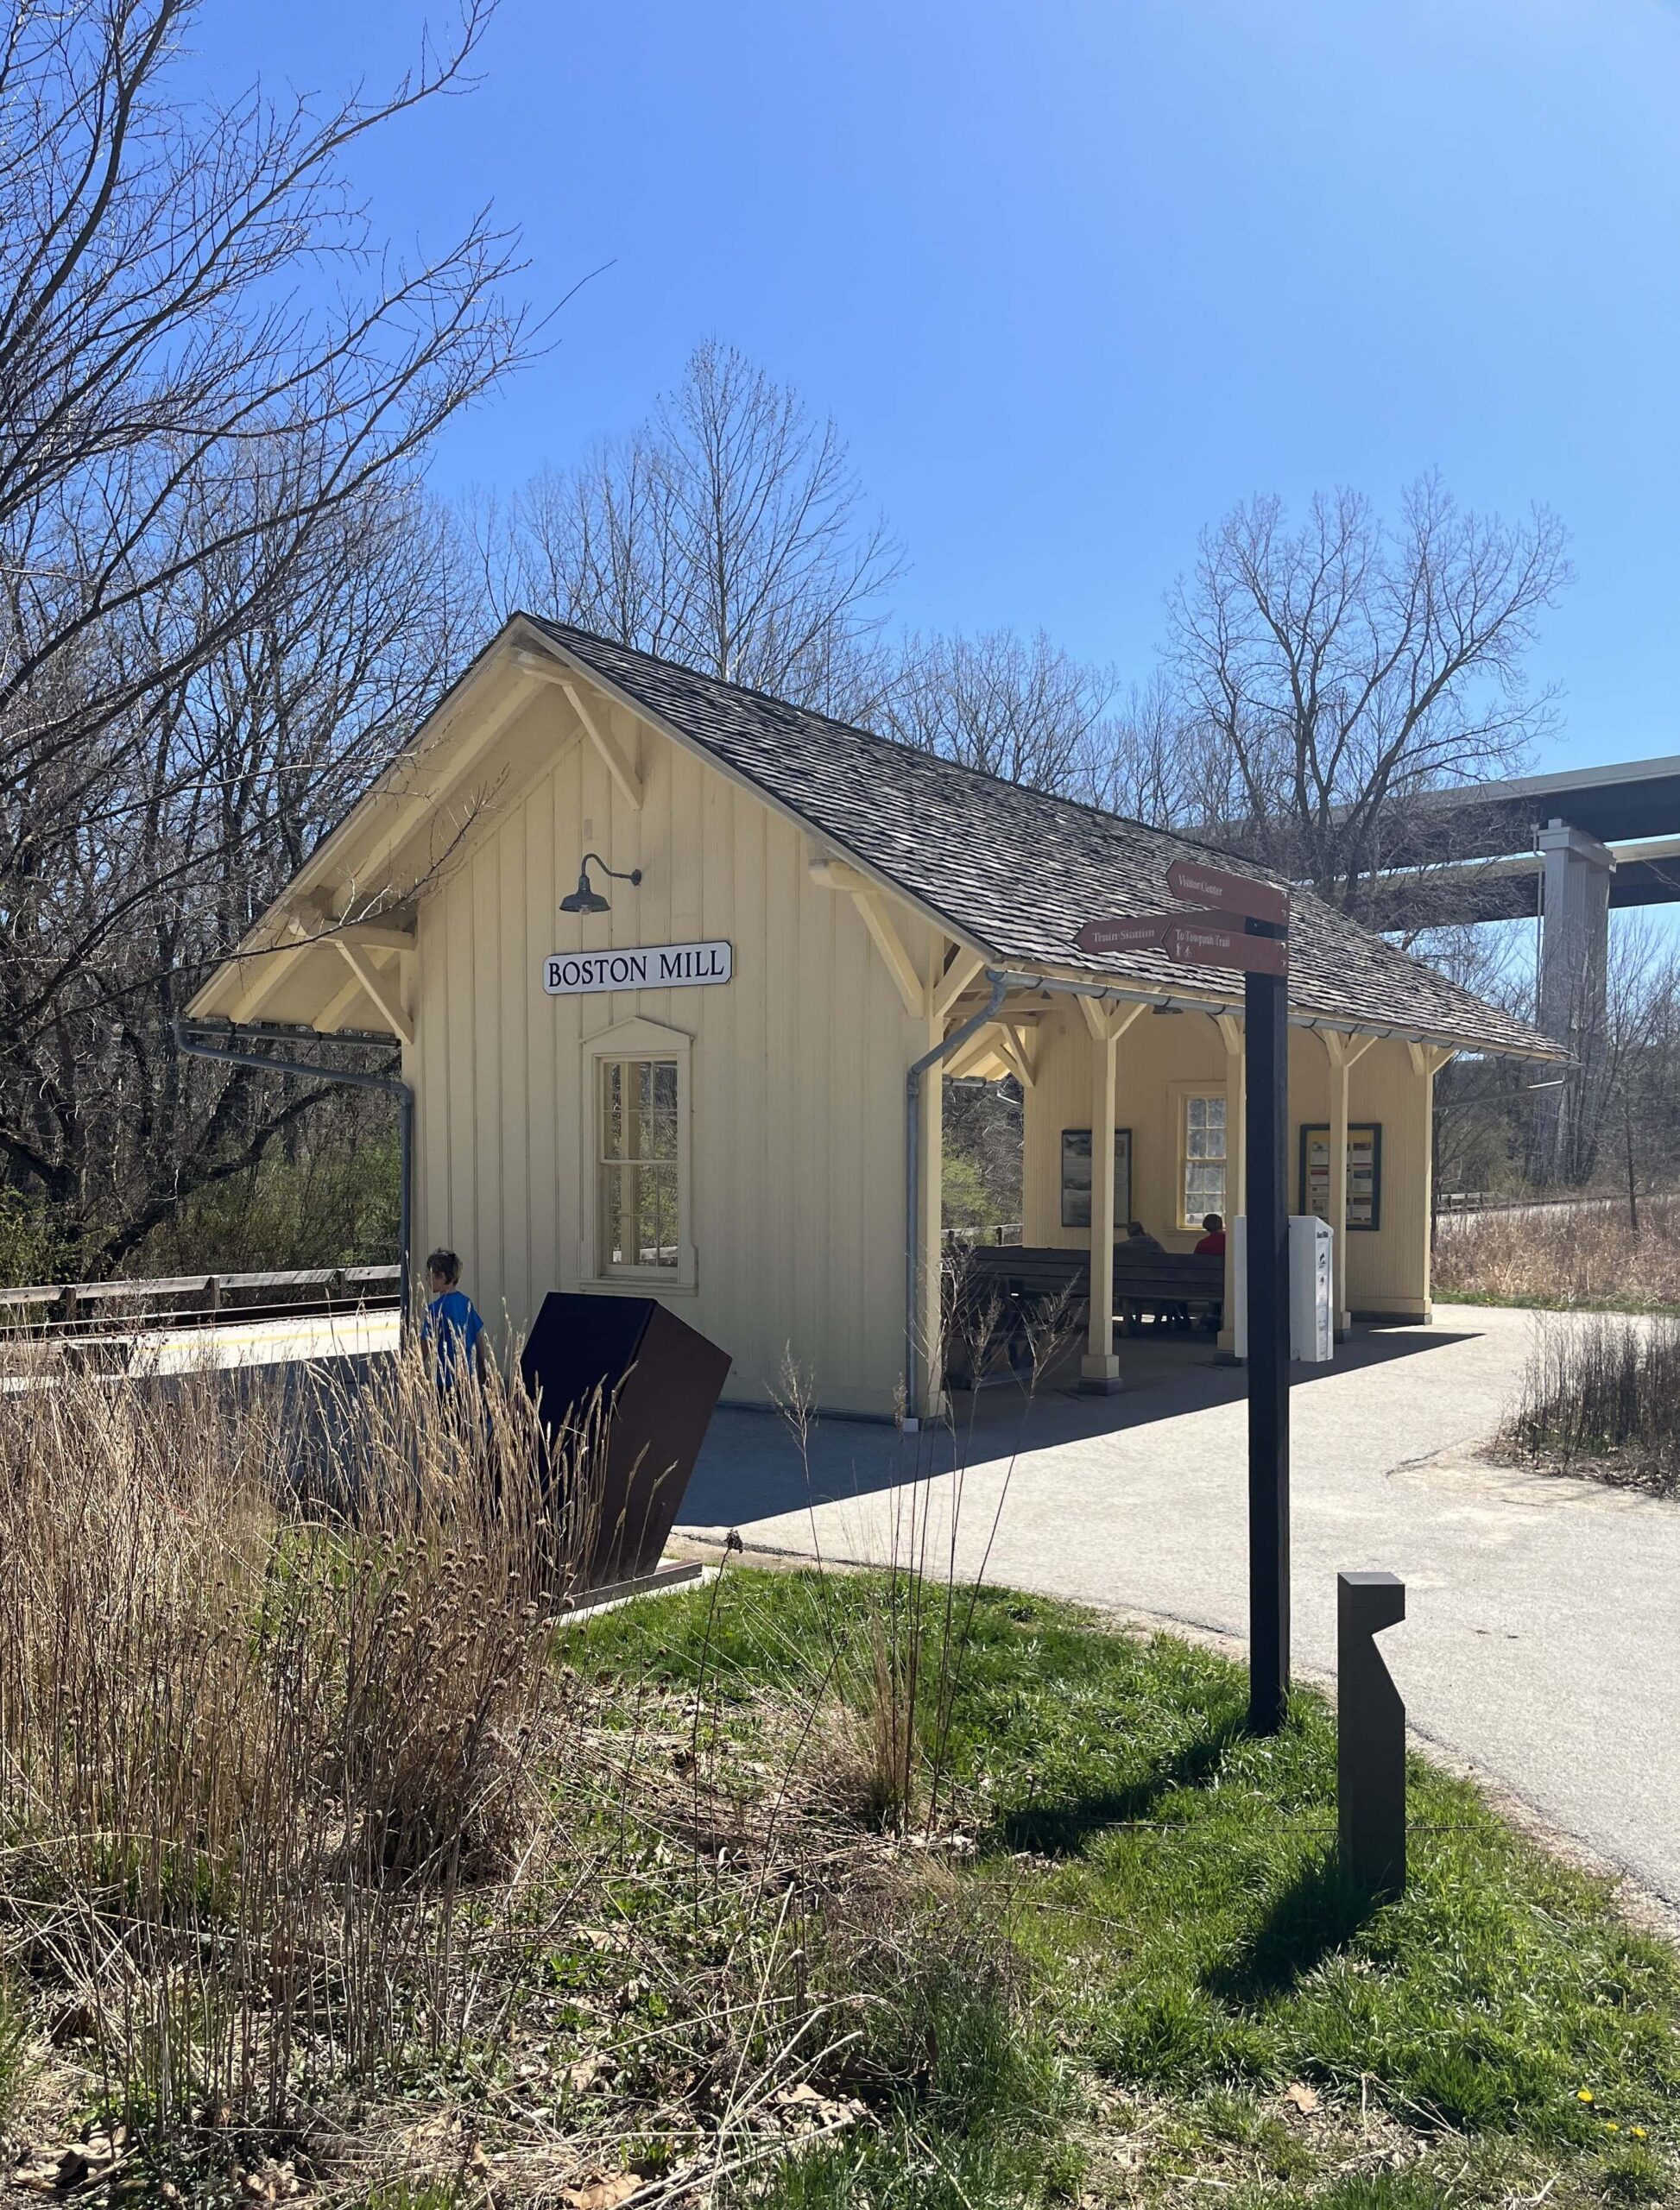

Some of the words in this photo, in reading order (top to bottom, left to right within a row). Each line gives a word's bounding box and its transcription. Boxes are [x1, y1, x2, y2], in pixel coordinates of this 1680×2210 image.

[1178, 875, 1200, 890] Visitor
[1201, 881, 1222, 896] Center
[1092, 931, 1118, 943] Train
[1121, 929, 1154, 940] Station
[1175, 928, 1184, 941] To
[1185, 931, 1214, 947] Towpath
[1215, 934, 1230, 947] Trail
[548, 956, 647, 988] BOSTON
[659, 950, 724, 979] MILL
